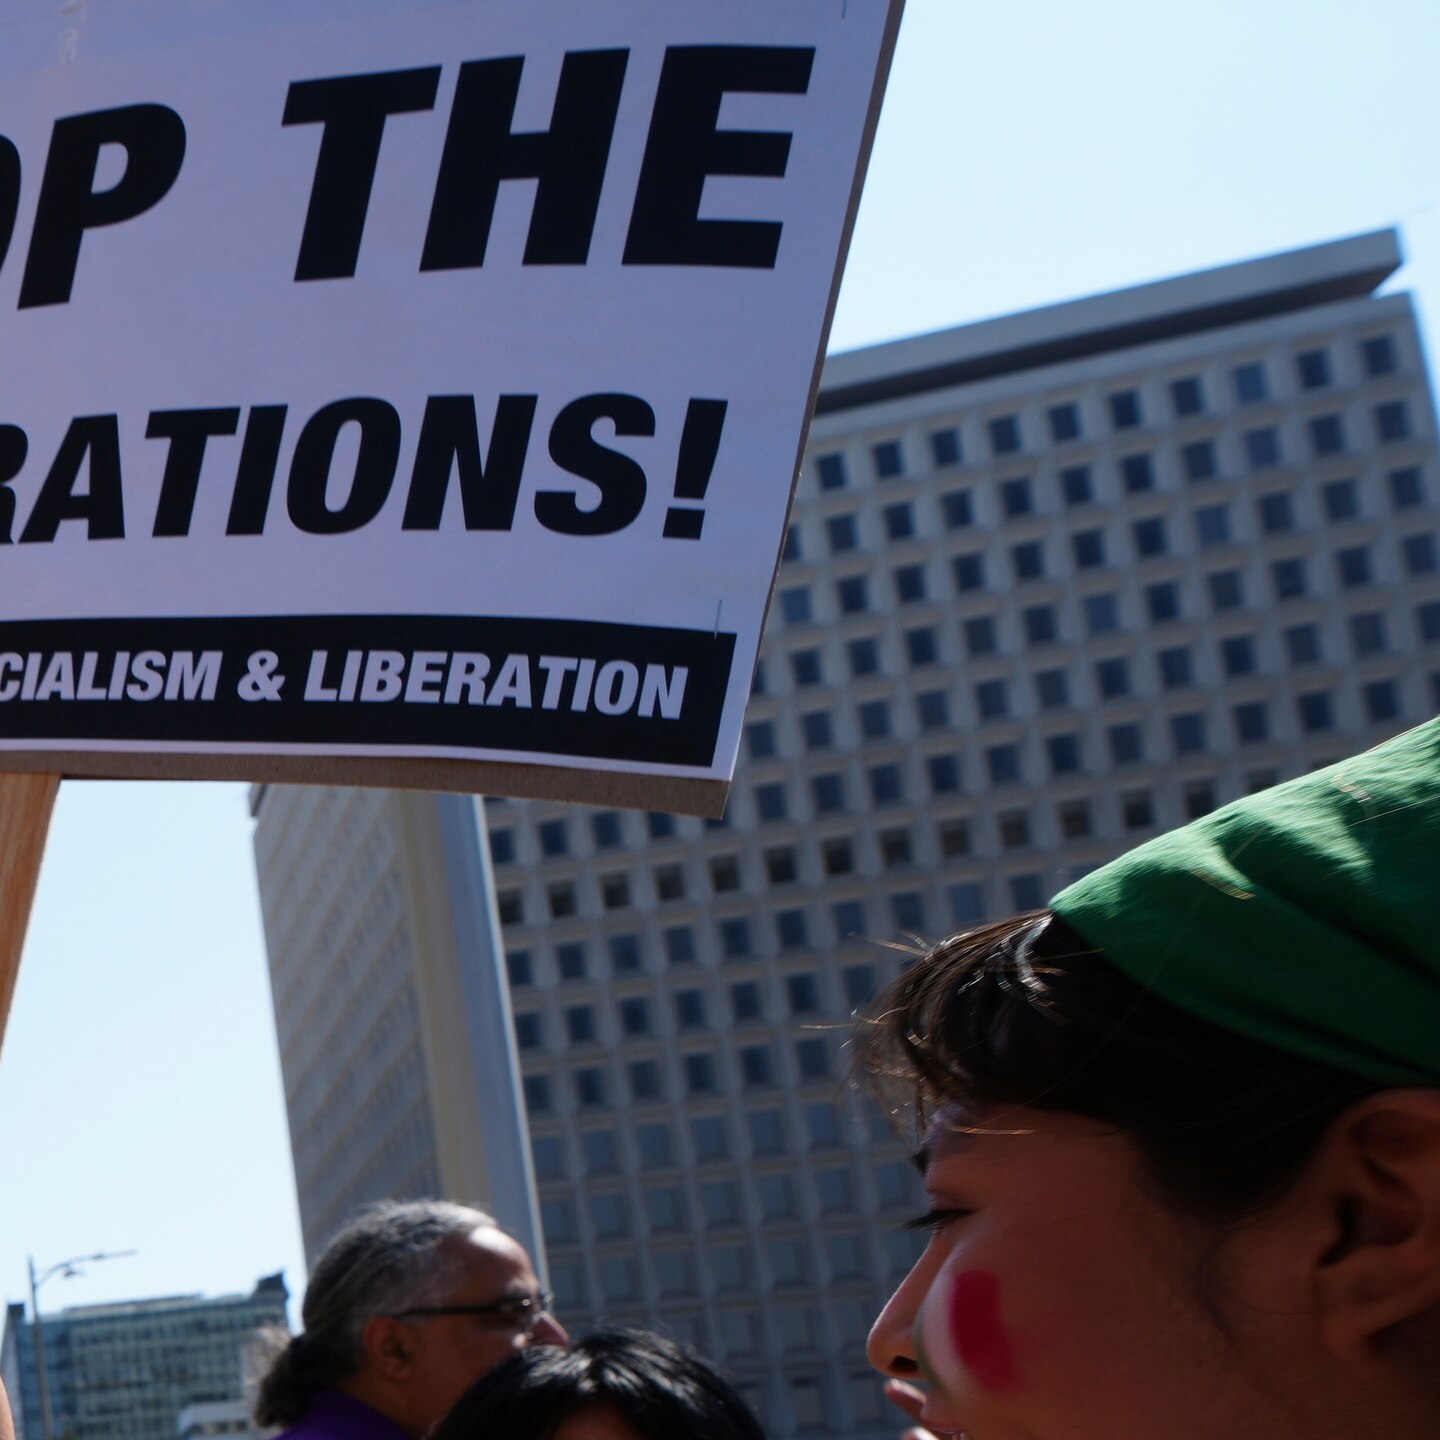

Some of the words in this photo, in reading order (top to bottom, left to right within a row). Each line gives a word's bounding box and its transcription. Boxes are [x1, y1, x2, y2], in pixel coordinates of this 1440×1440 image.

[281, 44, 817, 282] THE
[237, 650, 286, 702] &
[303, 650, 689, 720] LIBERATION
